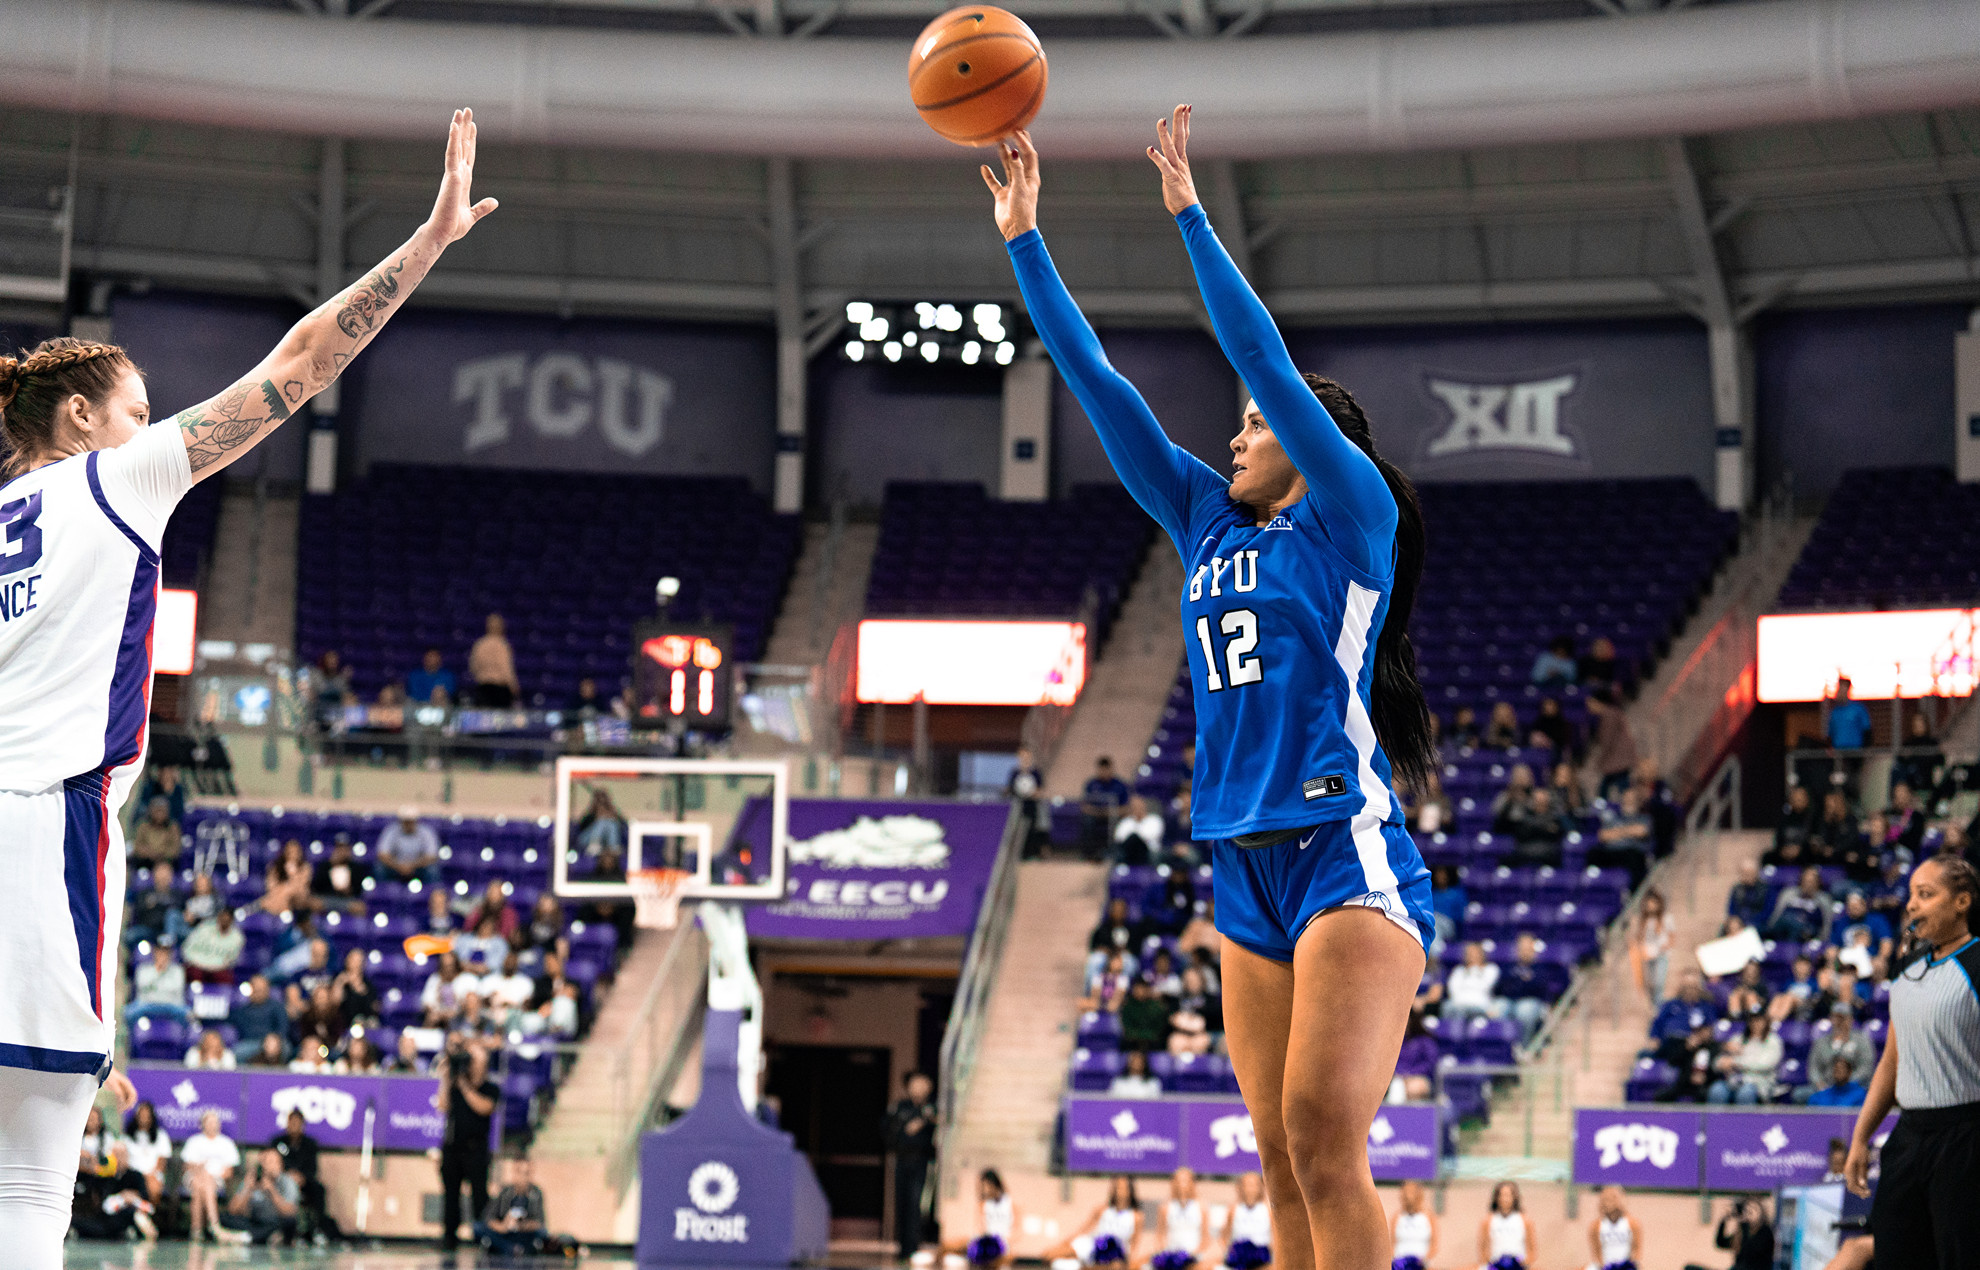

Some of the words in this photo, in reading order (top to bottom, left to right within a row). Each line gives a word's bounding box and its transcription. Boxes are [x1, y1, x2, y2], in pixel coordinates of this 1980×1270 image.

[453, 352, 676, 456] TCU
[1189, 550, 1259, 603] BYU
[1196, 607, 1264, 694] 12
[1331, 781, 1338, 789] L
[271, 1085, 357, 1131] TCU
[1594, 1123, 1679, 1169] TCU
